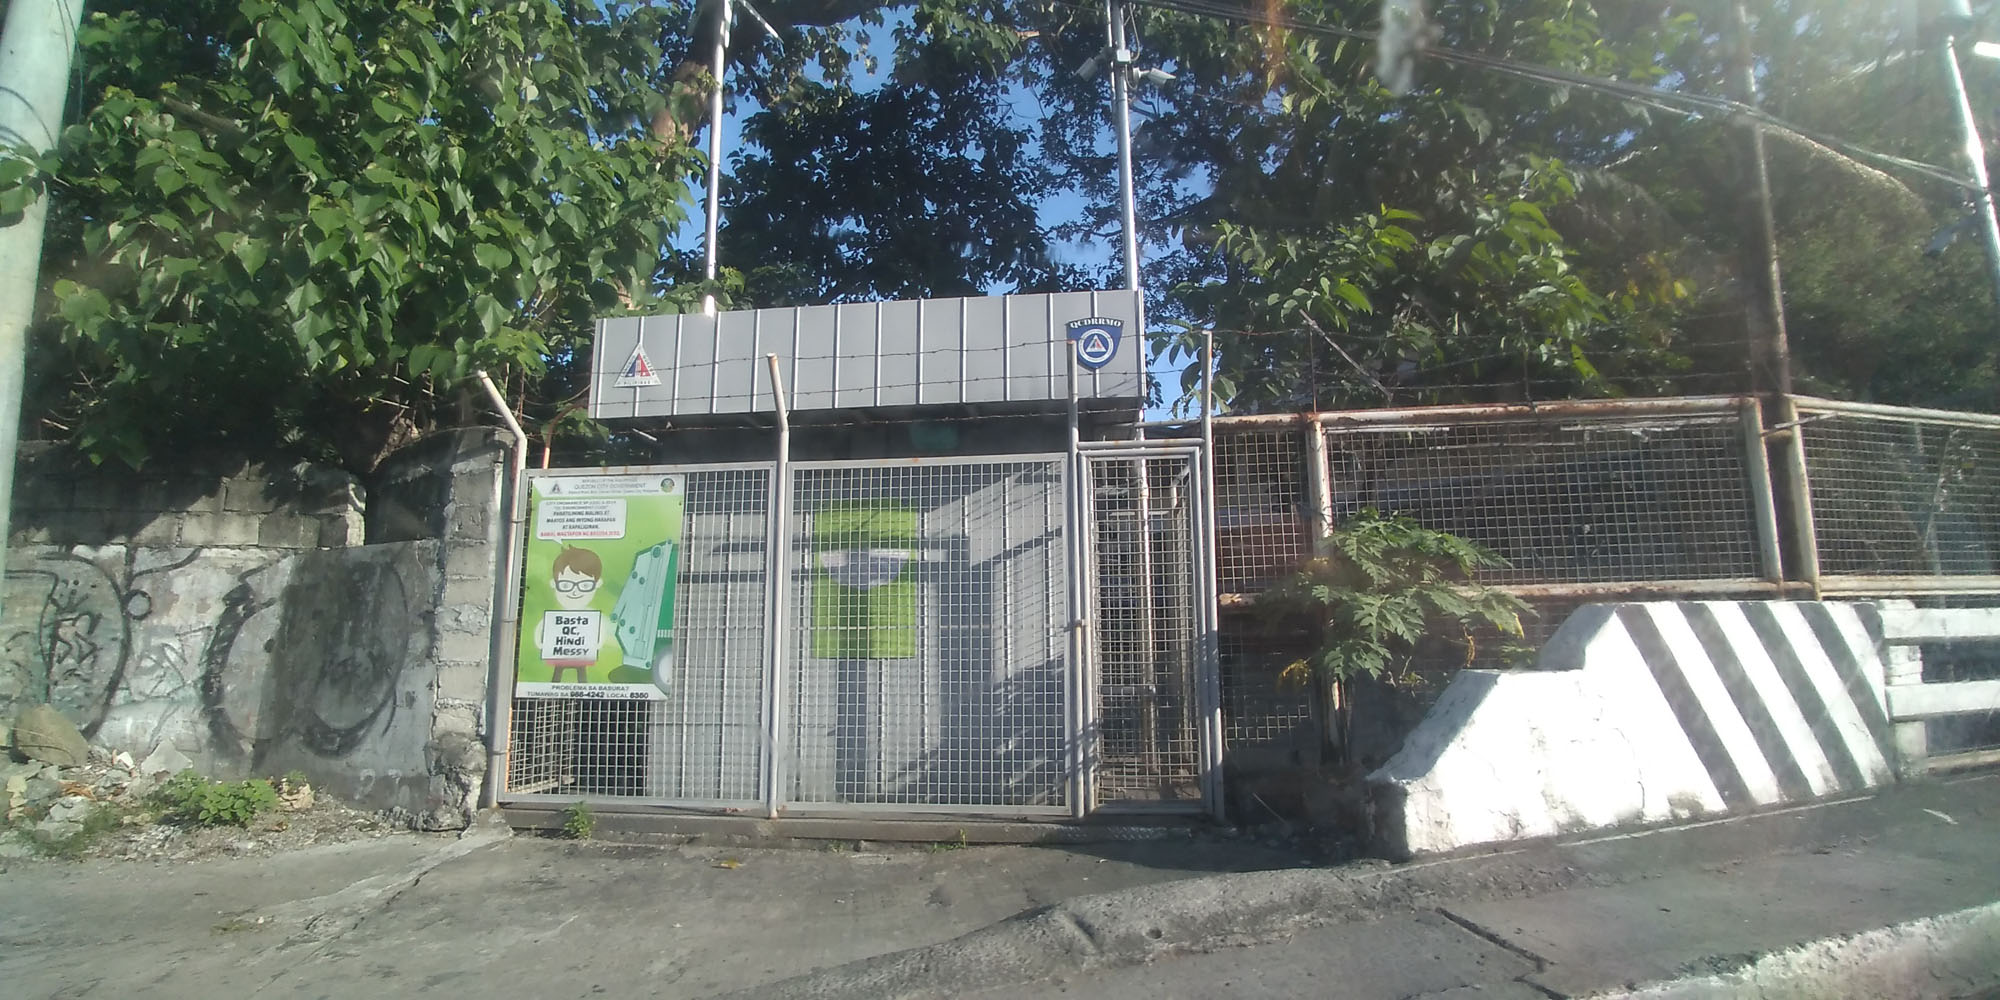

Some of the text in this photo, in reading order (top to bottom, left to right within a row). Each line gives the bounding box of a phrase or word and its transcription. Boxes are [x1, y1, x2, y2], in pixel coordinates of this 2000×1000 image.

[1070, 318, 1121, 328] QCDRRMO
[555, 616, 589, 625] Basta
[562, 626, 580, 635] QC,
[553, 647, 589, 655] Messy
